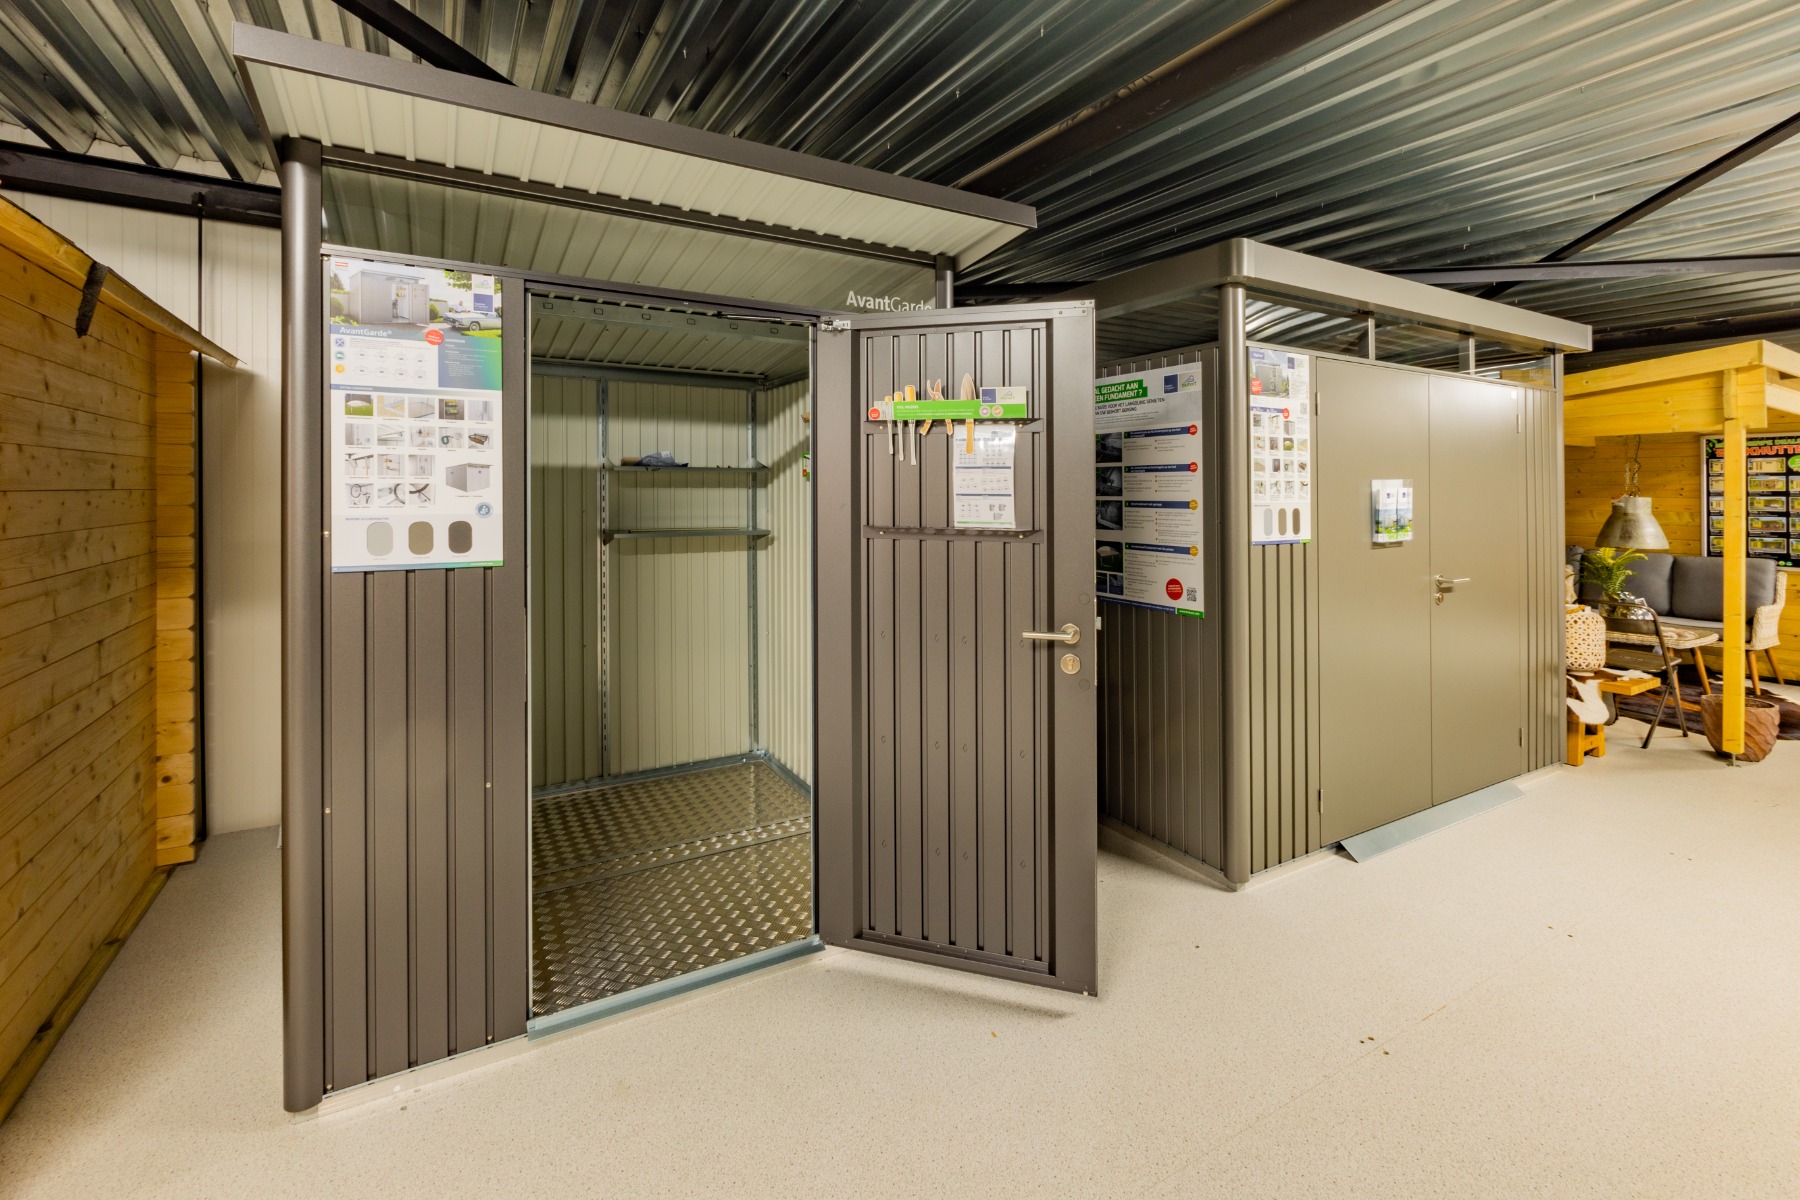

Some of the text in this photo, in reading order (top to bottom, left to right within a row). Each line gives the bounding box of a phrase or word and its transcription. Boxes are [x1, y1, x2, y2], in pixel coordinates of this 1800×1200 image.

[1101, 383, 1125, 394] GEDACHT
[1126, 382, 1139, 391] AAN
[1104, 390, 1138, 401] FUNDAMENT
